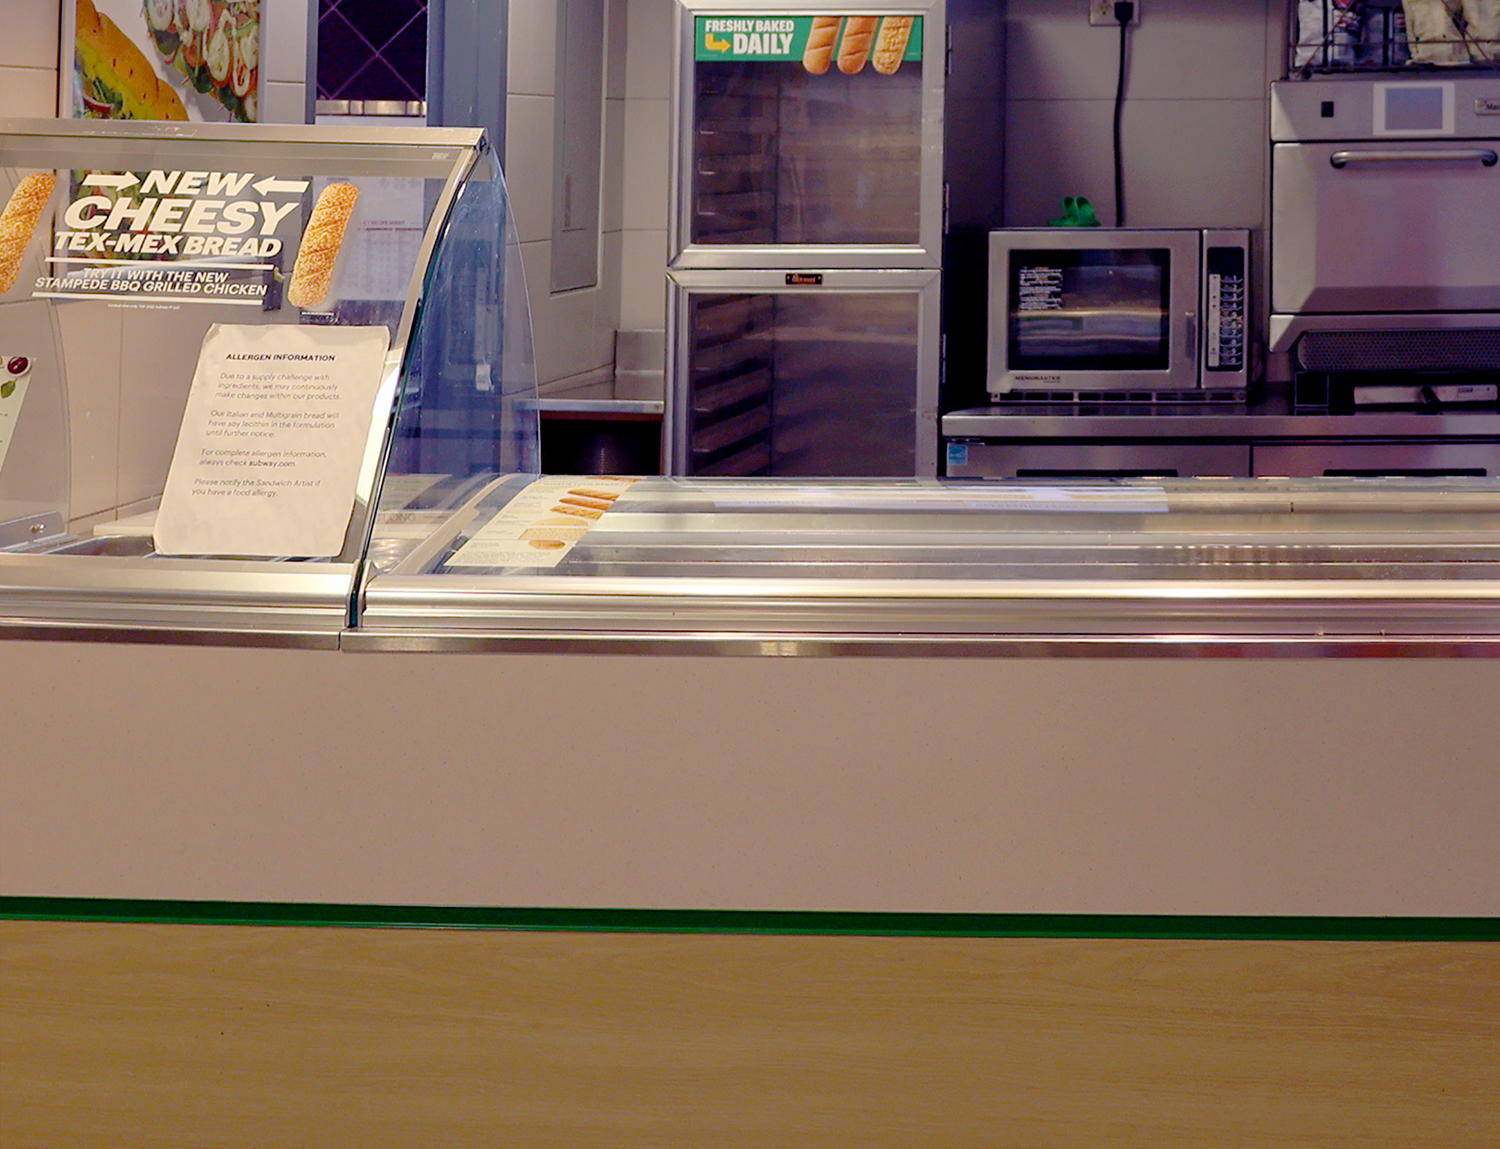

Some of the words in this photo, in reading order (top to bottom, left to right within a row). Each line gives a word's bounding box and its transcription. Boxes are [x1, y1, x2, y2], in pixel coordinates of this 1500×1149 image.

[705, 20, 755, 32] FRESHLY
[756, 20, 795, 32] BAKED
[733, 33, 794, 54] DAILY
[139, 170, 255, 196] NEW
[64, 195, 300, 235] CHEESY
[54, 231, 184, 255] TEX-MEX
[182, 235, 283, 258] BREAD
[83, 268, 110, 279] TRY
[111, 268, 122, 279] IT
[128, 269, 165, 281] WITH
[166, 270, 194, 282] THE
[195, 271, 229, 283] NEW
[35, 277, 109, 291] STAMPEDE
[111, 279, 140, 292] BBQ
[143, 281, 201, 294] GRILLED
[203, 282, 268, 296] CHICKEN
[251, 450, 281, 458] allergen
[220, 479, 241, 487] notify
